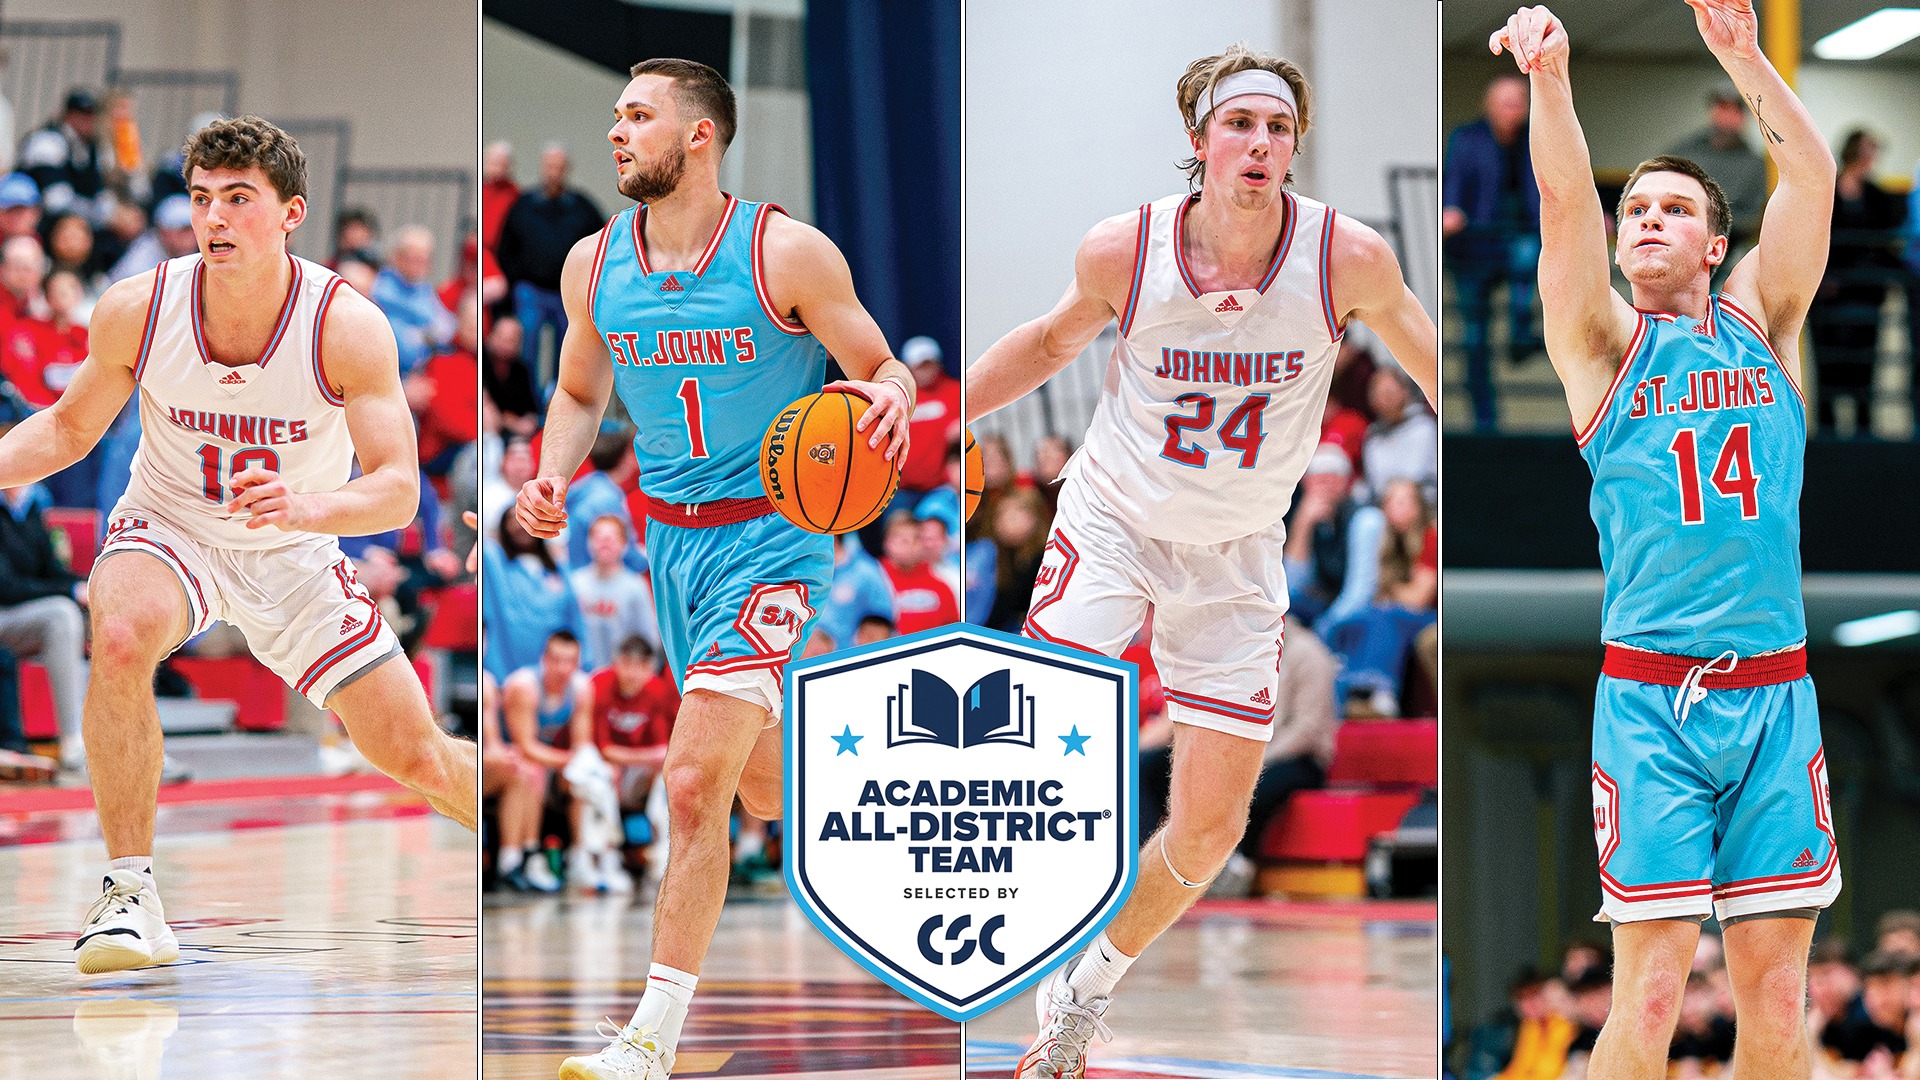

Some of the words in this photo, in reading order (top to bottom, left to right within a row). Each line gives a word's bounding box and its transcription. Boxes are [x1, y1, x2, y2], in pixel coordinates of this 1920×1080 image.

[1154, 346, 1305, 387] JOHNNIES
[168, 405, 309, 445] JOHNNIES
[676, 377, 710, 459] 1
[1159, 392, 1271, 469] 24
[767, 407, 802, 501] Wilson
[1667, 423, 1762, 526] 14
[339, 620, 364, 636] adidas
[1791, 859, 1819, 868] adidas
